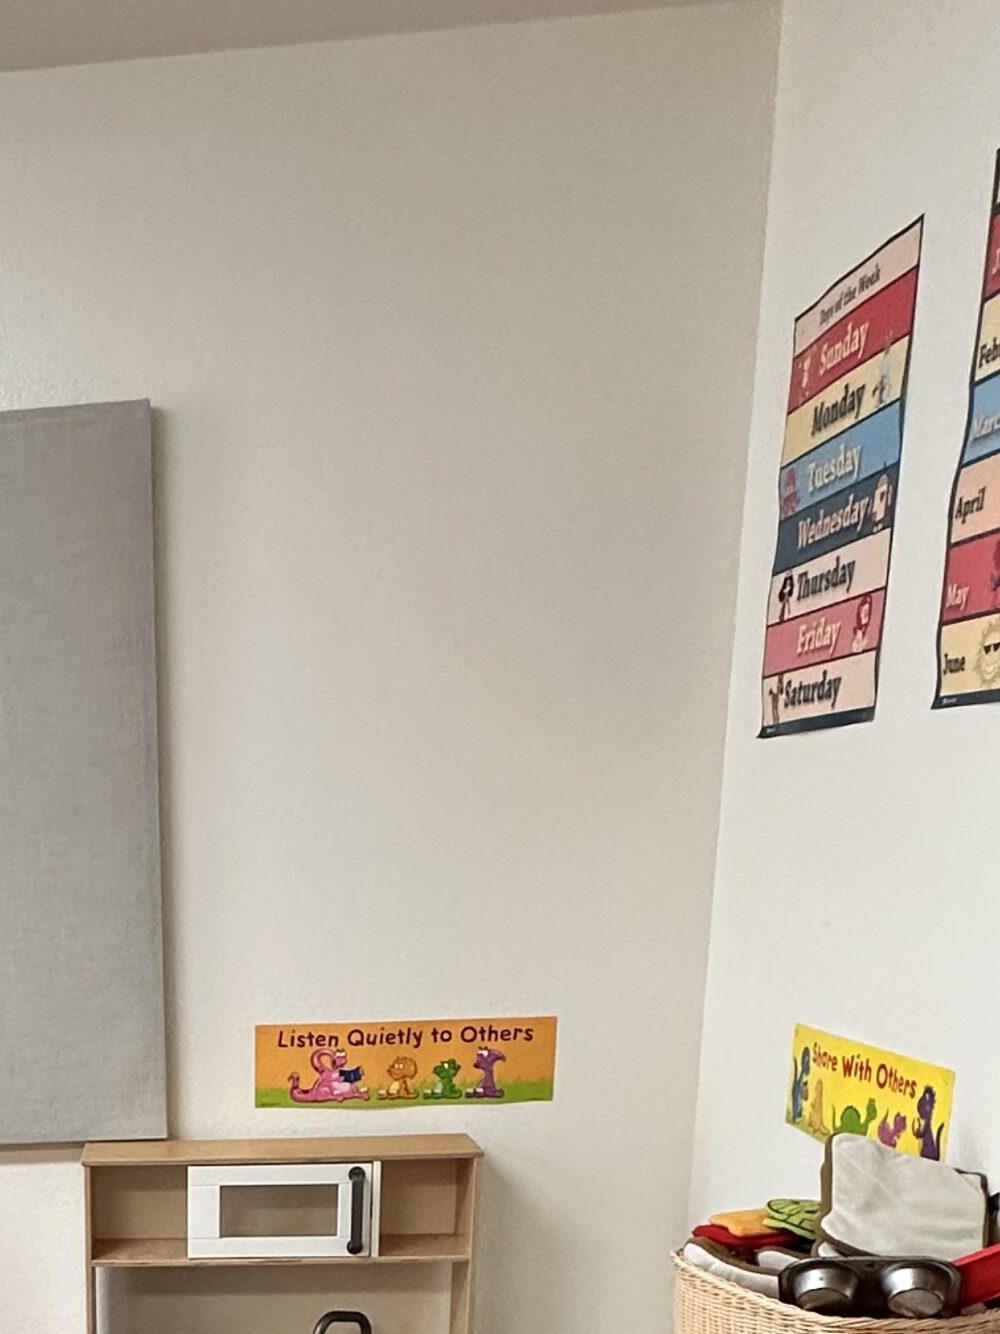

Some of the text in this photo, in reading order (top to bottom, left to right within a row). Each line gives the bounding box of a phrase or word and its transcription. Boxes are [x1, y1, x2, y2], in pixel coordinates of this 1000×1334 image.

[819, 321, 869, 376] Sunday
[811, 383, 866, 436] Monday
[807, 443, 862, 492] Tuesday
[797, 494, 871, 550] Wednesday
[955, 486, 986, 525] April
[797, 556, 856, 602] Thursday
[945, 585, 969, 610] May
[797, 620, 841, 655] Friday
[943, 653, 966, 675] June
[783, 669, 842, 710] Saturday
[278, 1026, 534, 1048] Listen Quietly to Others
[812, 1042, 917, 1099] Share With Others
